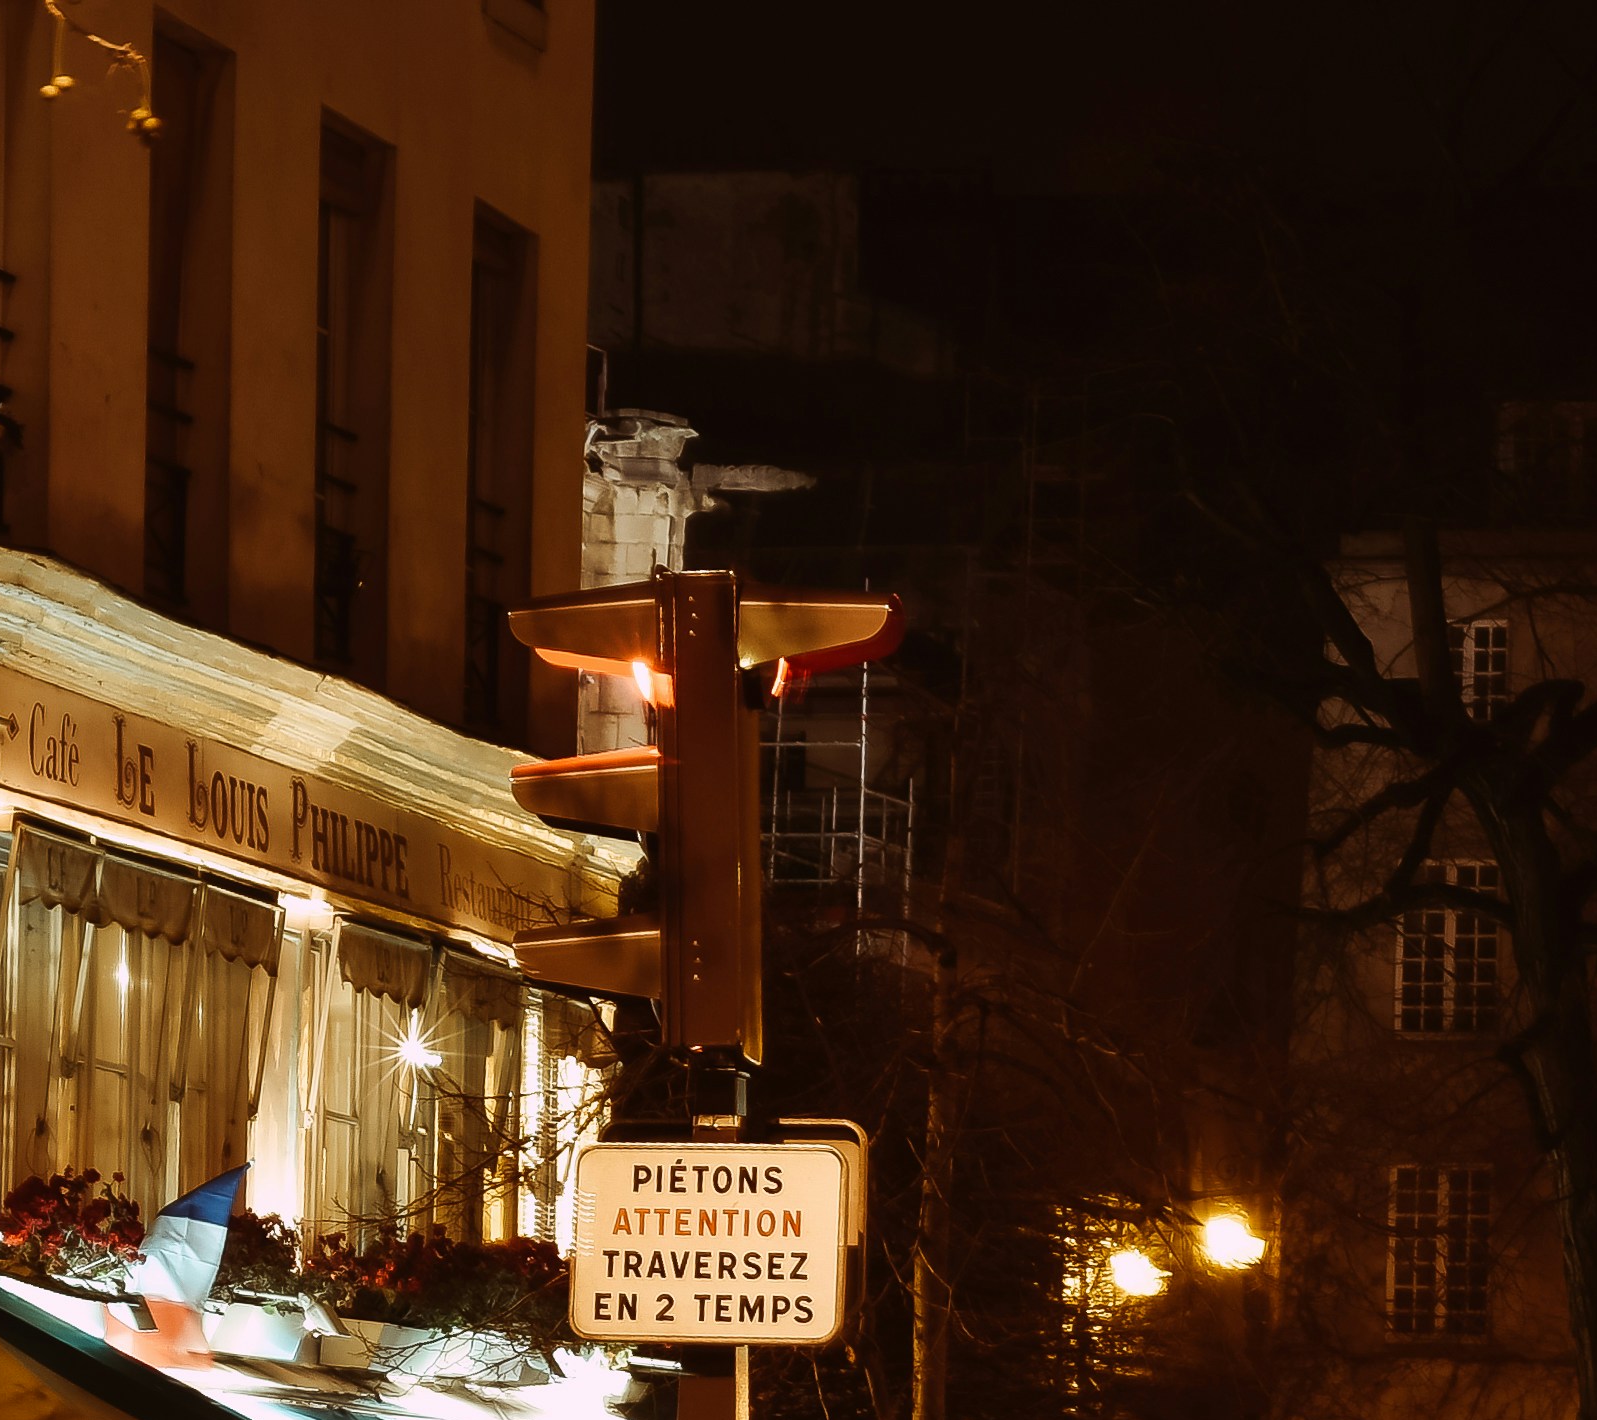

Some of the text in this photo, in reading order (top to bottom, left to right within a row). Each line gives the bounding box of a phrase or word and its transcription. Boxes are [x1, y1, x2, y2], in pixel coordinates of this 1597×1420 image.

[28, 702, 80, 788] Café
[112, 712, 155, 817] LE
[185, 739, 270, 852] LOUIS
[290, 776, 409, 898] PHILIPPE
[633, 1158, 784, 1195] PIÉTONS
[612, 1206, 802, 1237] ATTENTION
[603, 1250, 809, 1282] TRAVERSEZ
[594, 1292, 814, 1324] EN 2 TEMPS
